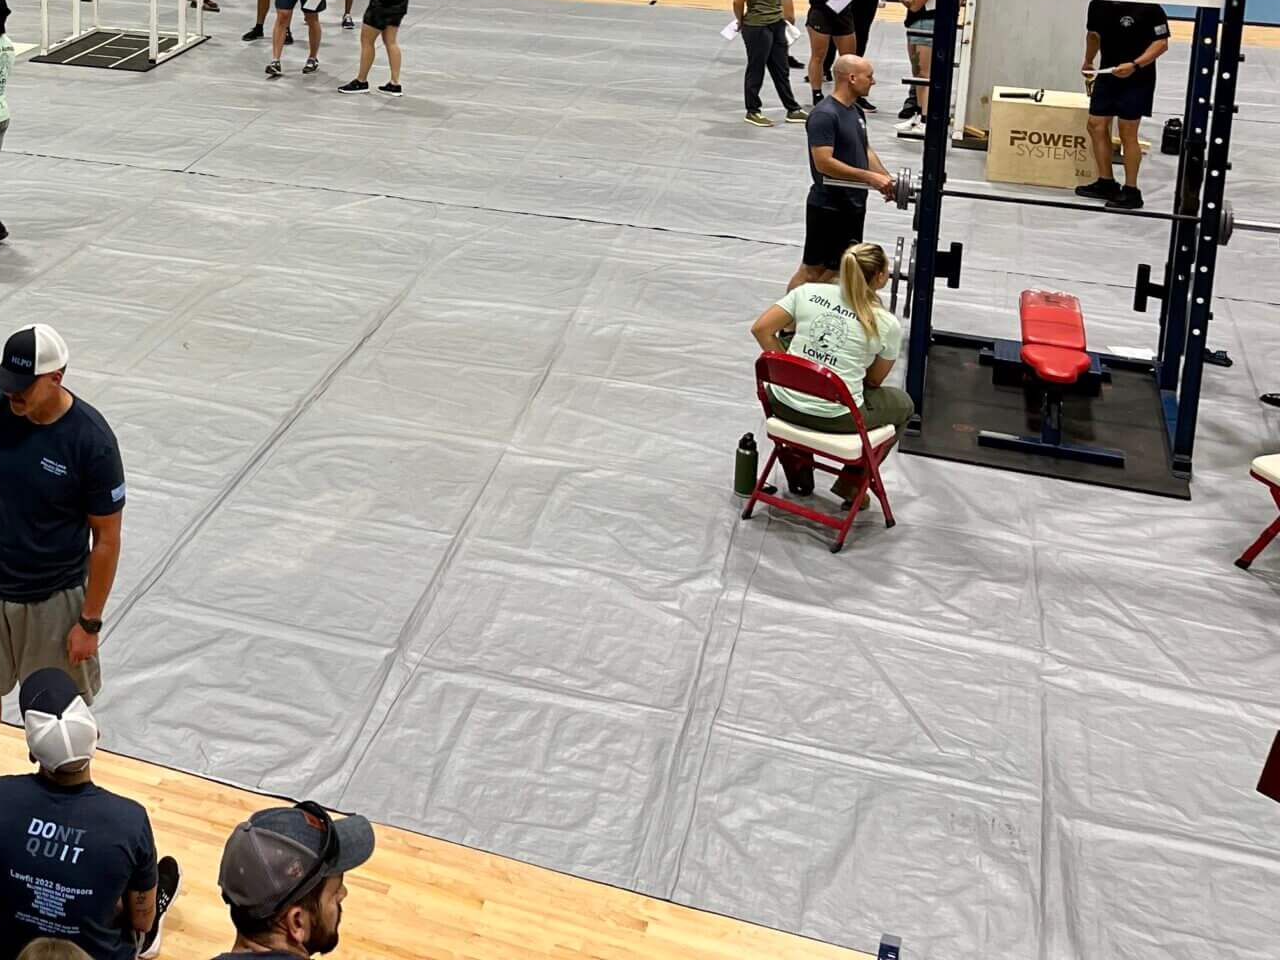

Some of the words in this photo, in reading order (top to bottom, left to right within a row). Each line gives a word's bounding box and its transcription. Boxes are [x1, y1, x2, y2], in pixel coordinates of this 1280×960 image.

[1009, 129, 1087, 150] POWER
[1016, 143, 1087, 162] SYSTEMS
[809, 294, 832, 309] 20th
[803, 343, 838, 366] LawFit
[27, 817, 88, 846] DON'T
[25, 837, 85, 864] QUIT
[34, 877, 55, 889] 2022
[55, 883, 94, 896] Sponsors
